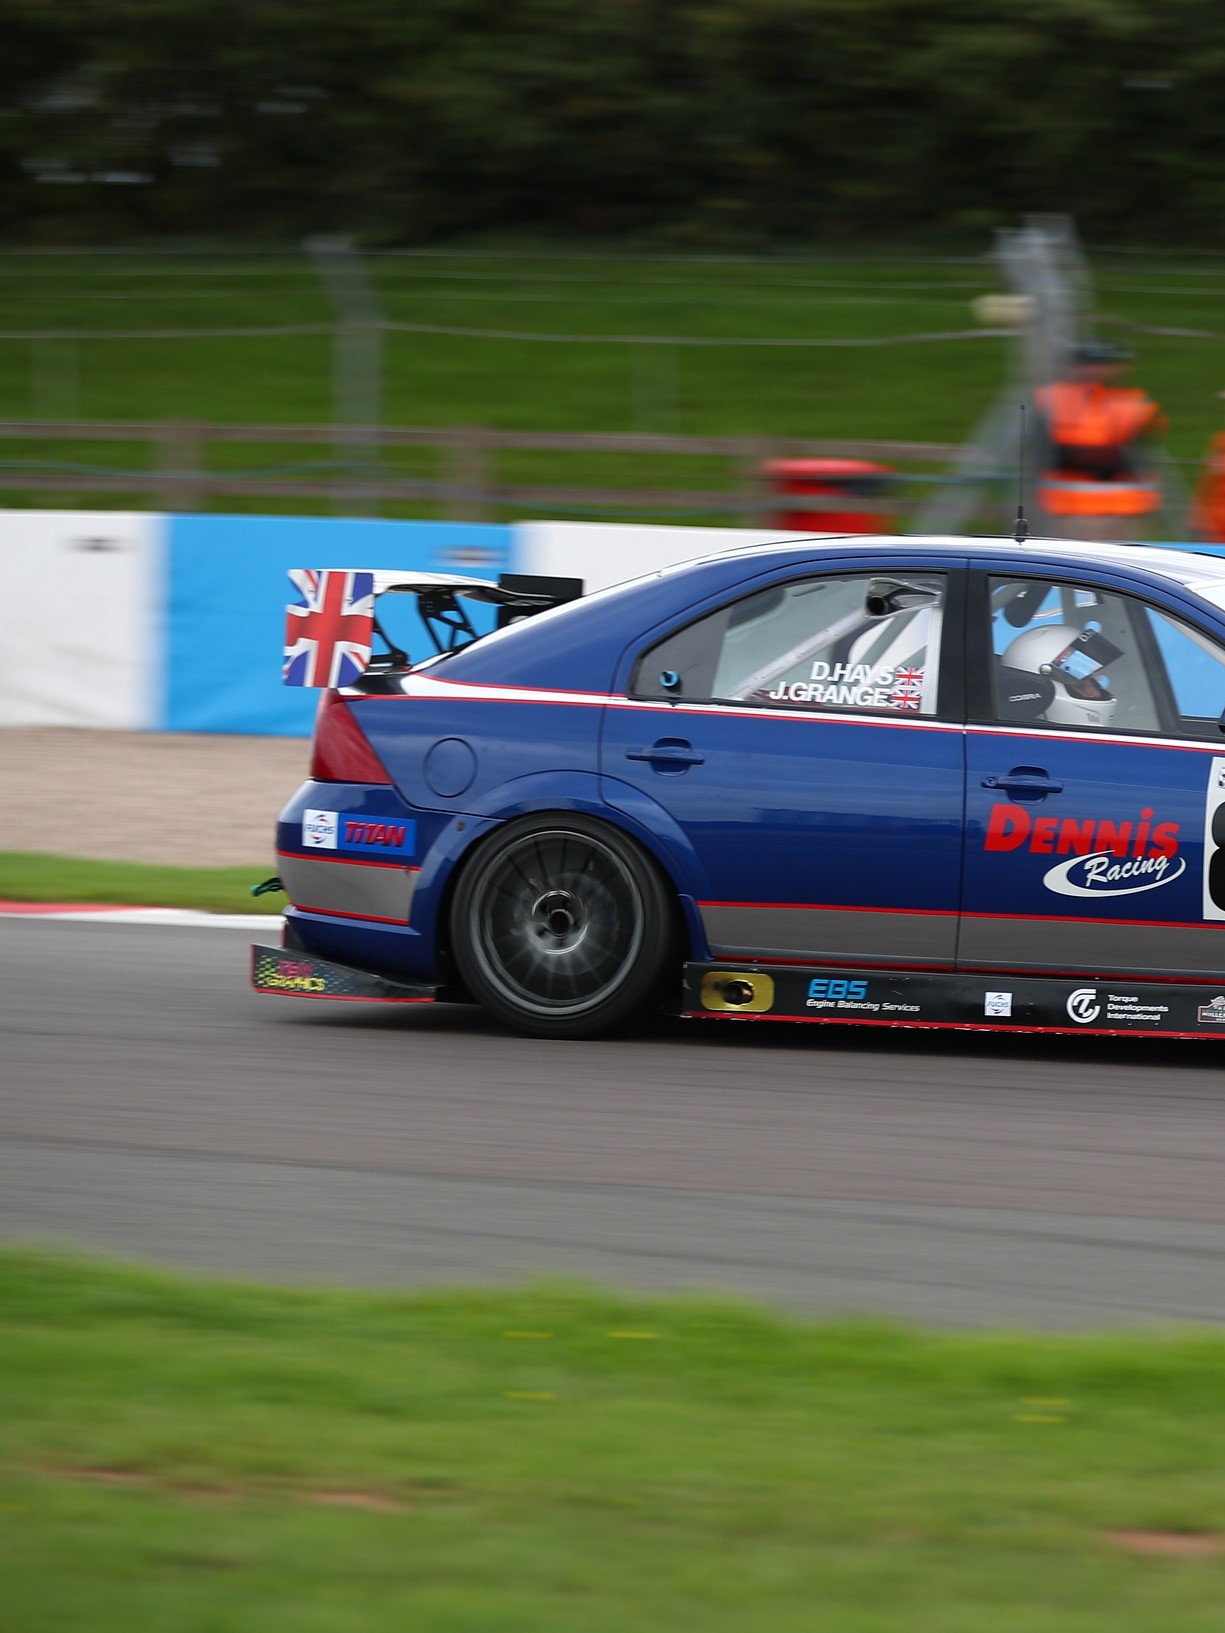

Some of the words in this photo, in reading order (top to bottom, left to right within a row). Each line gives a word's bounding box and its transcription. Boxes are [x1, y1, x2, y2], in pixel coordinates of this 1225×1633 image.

[809, 661, 895, 685] D.HAYS
[769, 681, 891, 707] J.GRANGE
[345, 821, 406, 847] TITAN
[1084, 854, 1170, 887] Racing
[807, 978, 869, 1000] EBS
[1107, 994, 1139, 1003] Torque
[805, 998, 836, 1009] Engine
[836, 1000, 881, 1012] Balancing
[881, 1002, 921, 1012] Services
[1107, 1003, 1169, 1013] Developments
